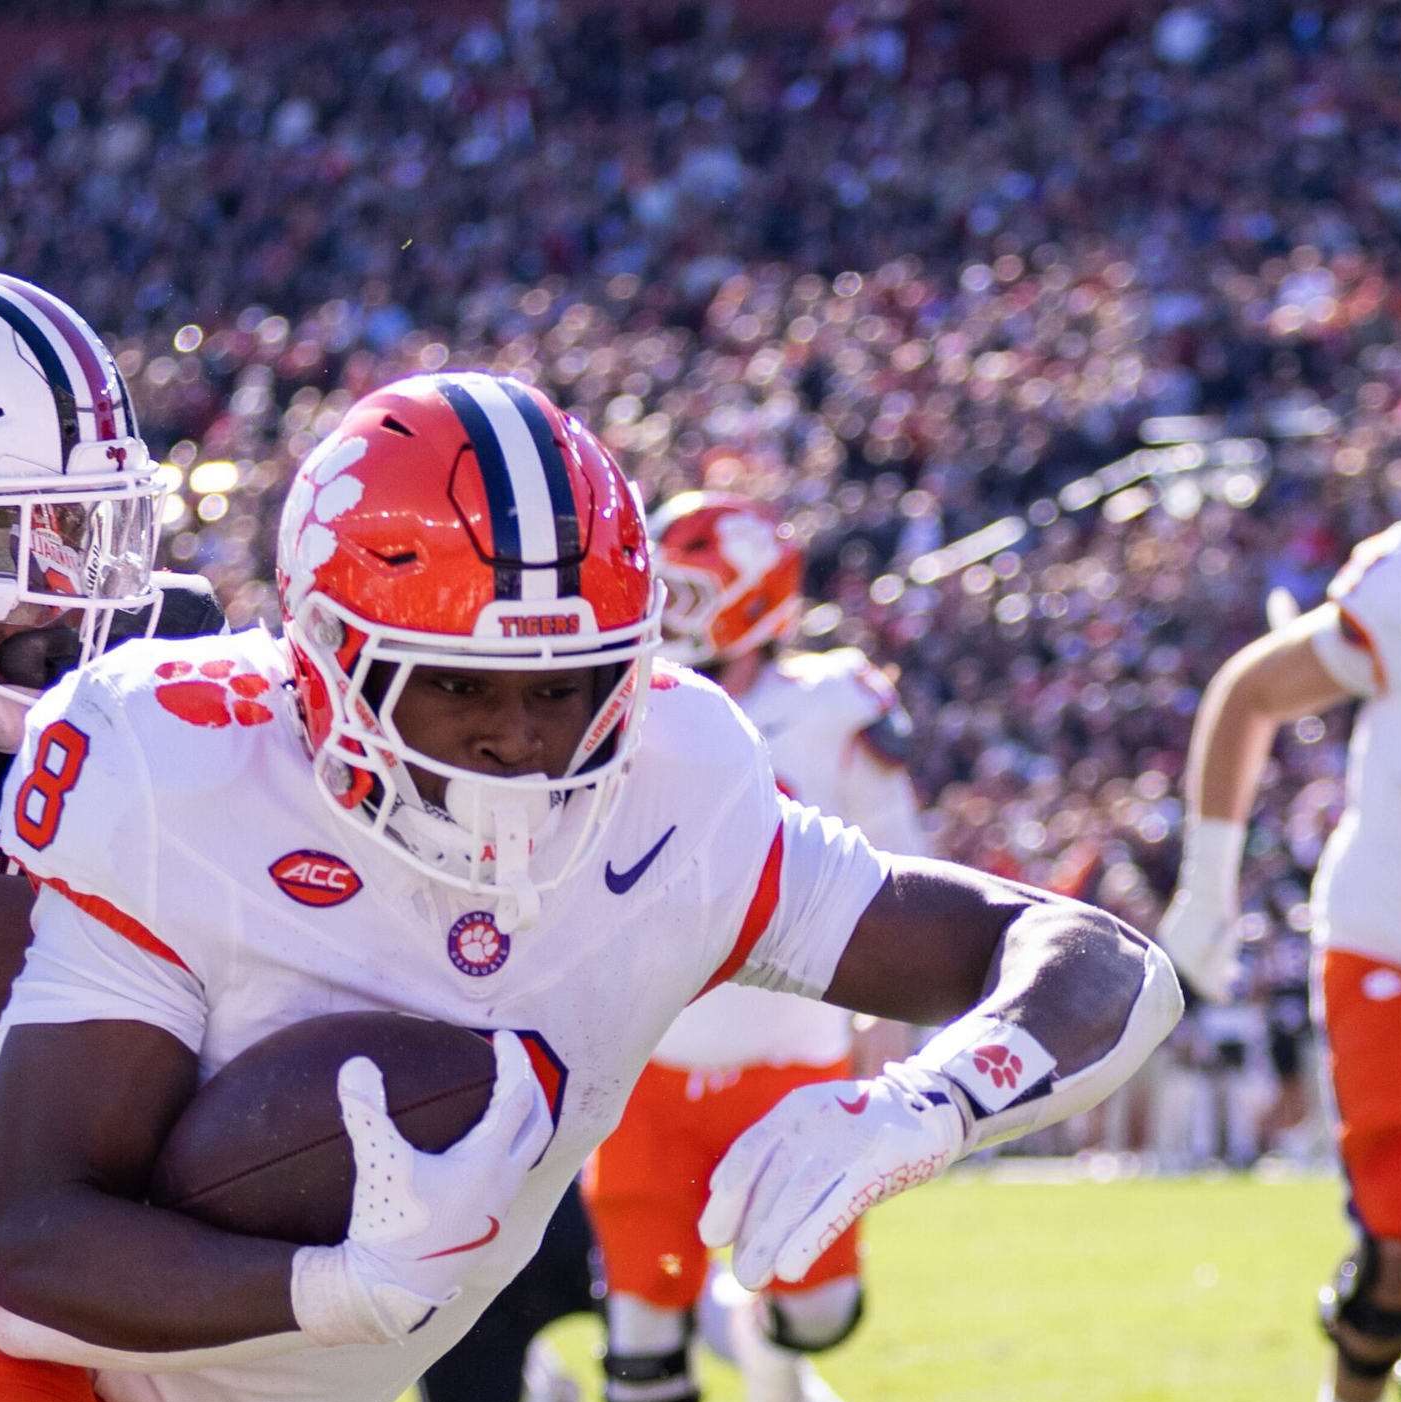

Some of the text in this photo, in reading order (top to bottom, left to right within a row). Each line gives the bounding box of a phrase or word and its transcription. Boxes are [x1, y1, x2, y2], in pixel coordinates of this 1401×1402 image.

[497, 613, 580, 637] TIGERS
[13, 718, 90, 852] 8
[282, 861, 353, 891] ACC
